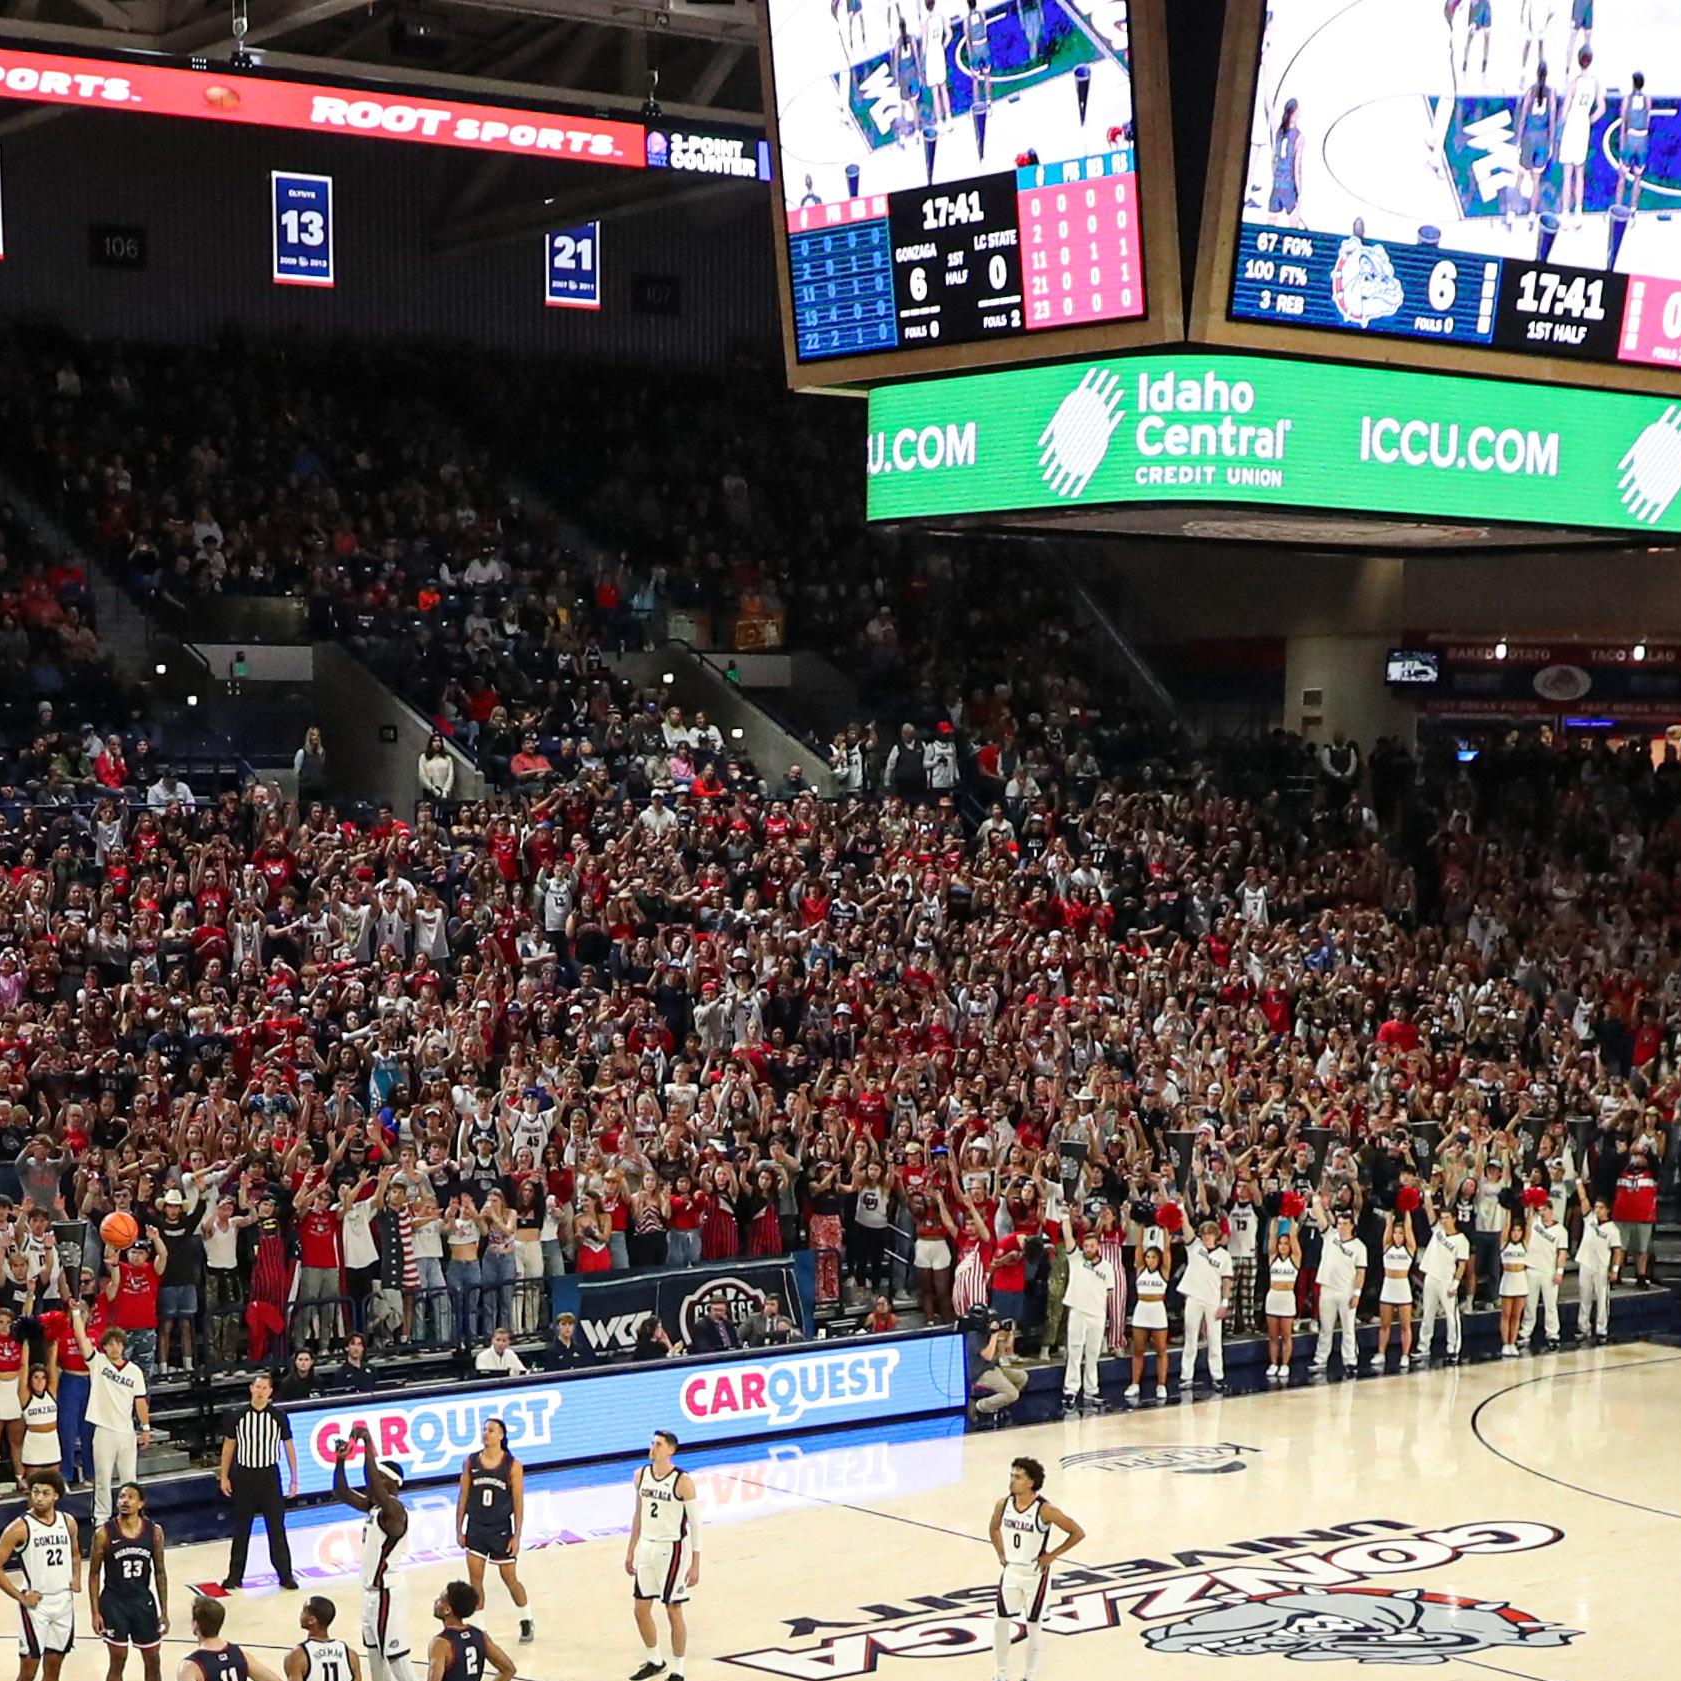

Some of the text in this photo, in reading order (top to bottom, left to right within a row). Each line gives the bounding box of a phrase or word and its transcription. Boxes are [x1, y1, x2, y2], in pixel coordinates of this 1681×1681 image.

[311, 96, 613, 156] ROOT SPORTS
[922, 191, 984, 230] 17:41
[1031, 189, 1095, 217] 0 0 0
[281, 209, 324, 246] 13
[103, 236, 139, 259] 106
[973, 230, 1017, 251] LC STATE
[1257, 232, 1278, 252] 67
[553, 235, 592, 271] 21
[896, 243, 937, 263] GONZAGA
[1033, 250, 1047, 269] 11
[945, 270, 969, 286] HALF
[989, 255, 1007, 290] 0
[1245, 261, 1274, 281] 100
[910, 267, 927, 301] 6
[1033, 276, 1048, 295] 21
[1428, 261, 1457, 311] 6
[1260, 291, 1304, 315] 3 REB
[1517, 271, 1605, 320] 17:41
[983, 309, 1021, 329] FOULS 2
[1034, 299, 1050, 319] 23
[904, 320, 939, 339] FOULS 0
[1443, 318, 1454, 333] 0
[1527, 322, 1587, 343] 1ST HALF
[1137, 370, 1255, 414] Idaho
[1135, 413, 1285, 460] Central
[1360, 414, 1559, 476] ICCU.COM
[1135, 464, 1284, 488] CREDIT UNION
[526, 1135, 539, 1147] 45
[102, 1366, 135, 1389] GONZAGA
[685, 1355, 890, 1421] CARQUEST
[316, 1397, 549, 1468] CARQUST
[482, 1490, 493, 1507] 0
[640, 1487, 671, 1502] GONZAGA
[650, 1502, 659, 1518] 2
[1003, 1518, 1035, 1534] GONZAGA
[33, 1534, 69, 1548] GONZAGA
[1013, 1533, 1021, 1549] 0
[46, 1548, 64, 1567] 22
[122, 1560, 147, 1580] 23
[465, 1645, 478, 1677] 2
